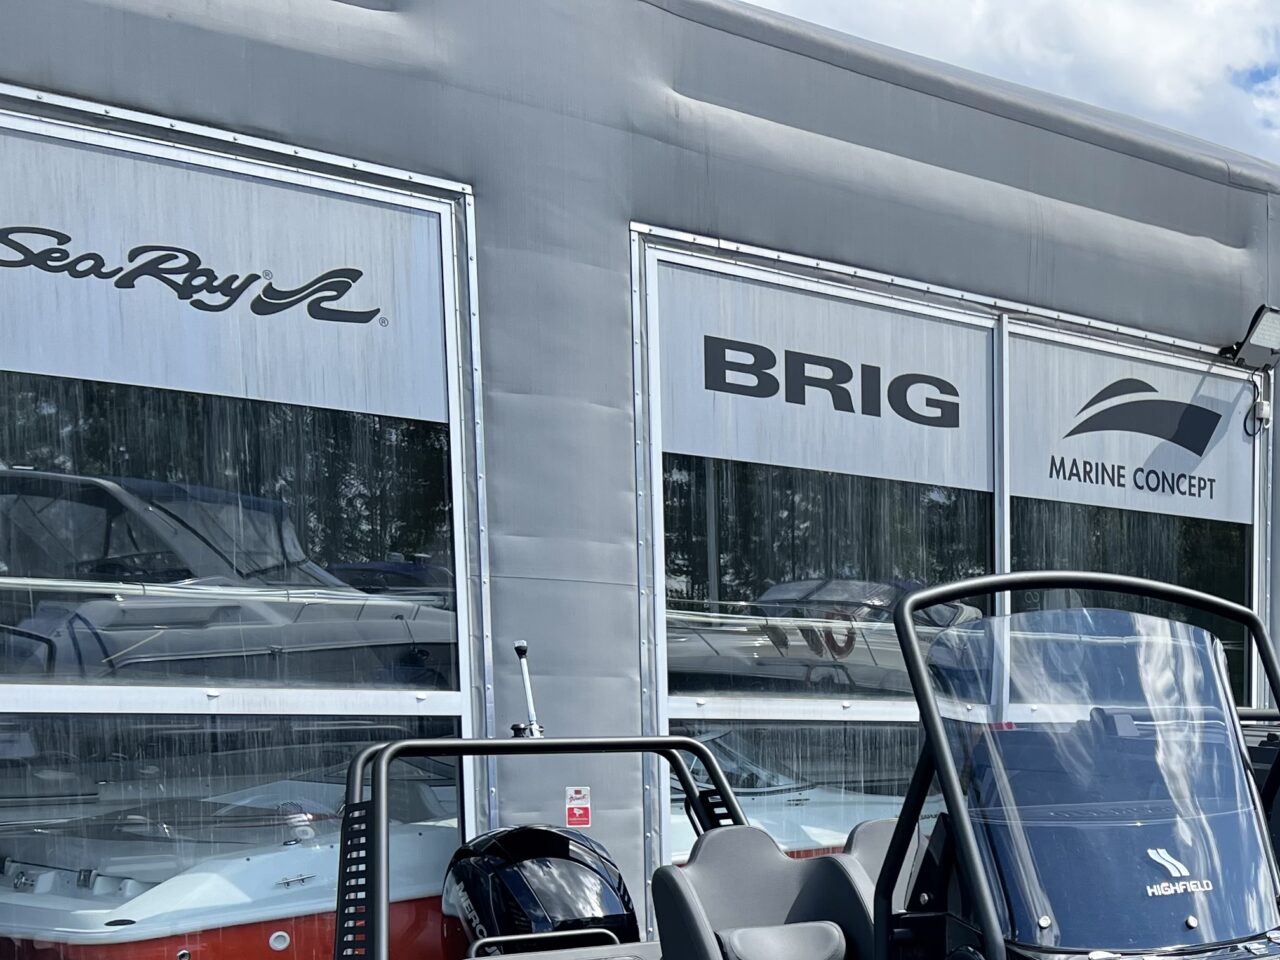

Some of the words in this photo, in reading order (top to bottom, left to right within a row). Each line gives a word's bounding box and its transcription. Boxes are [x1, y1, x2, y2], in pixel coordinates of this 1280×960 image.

[704, 335, 960, 428] BRIG
[1049, 455, 1126, 488] MARINE
[1133, 467, 1216, 500] CONCEPT
[1146, 880, 1213, 896] HIGHFIELD
